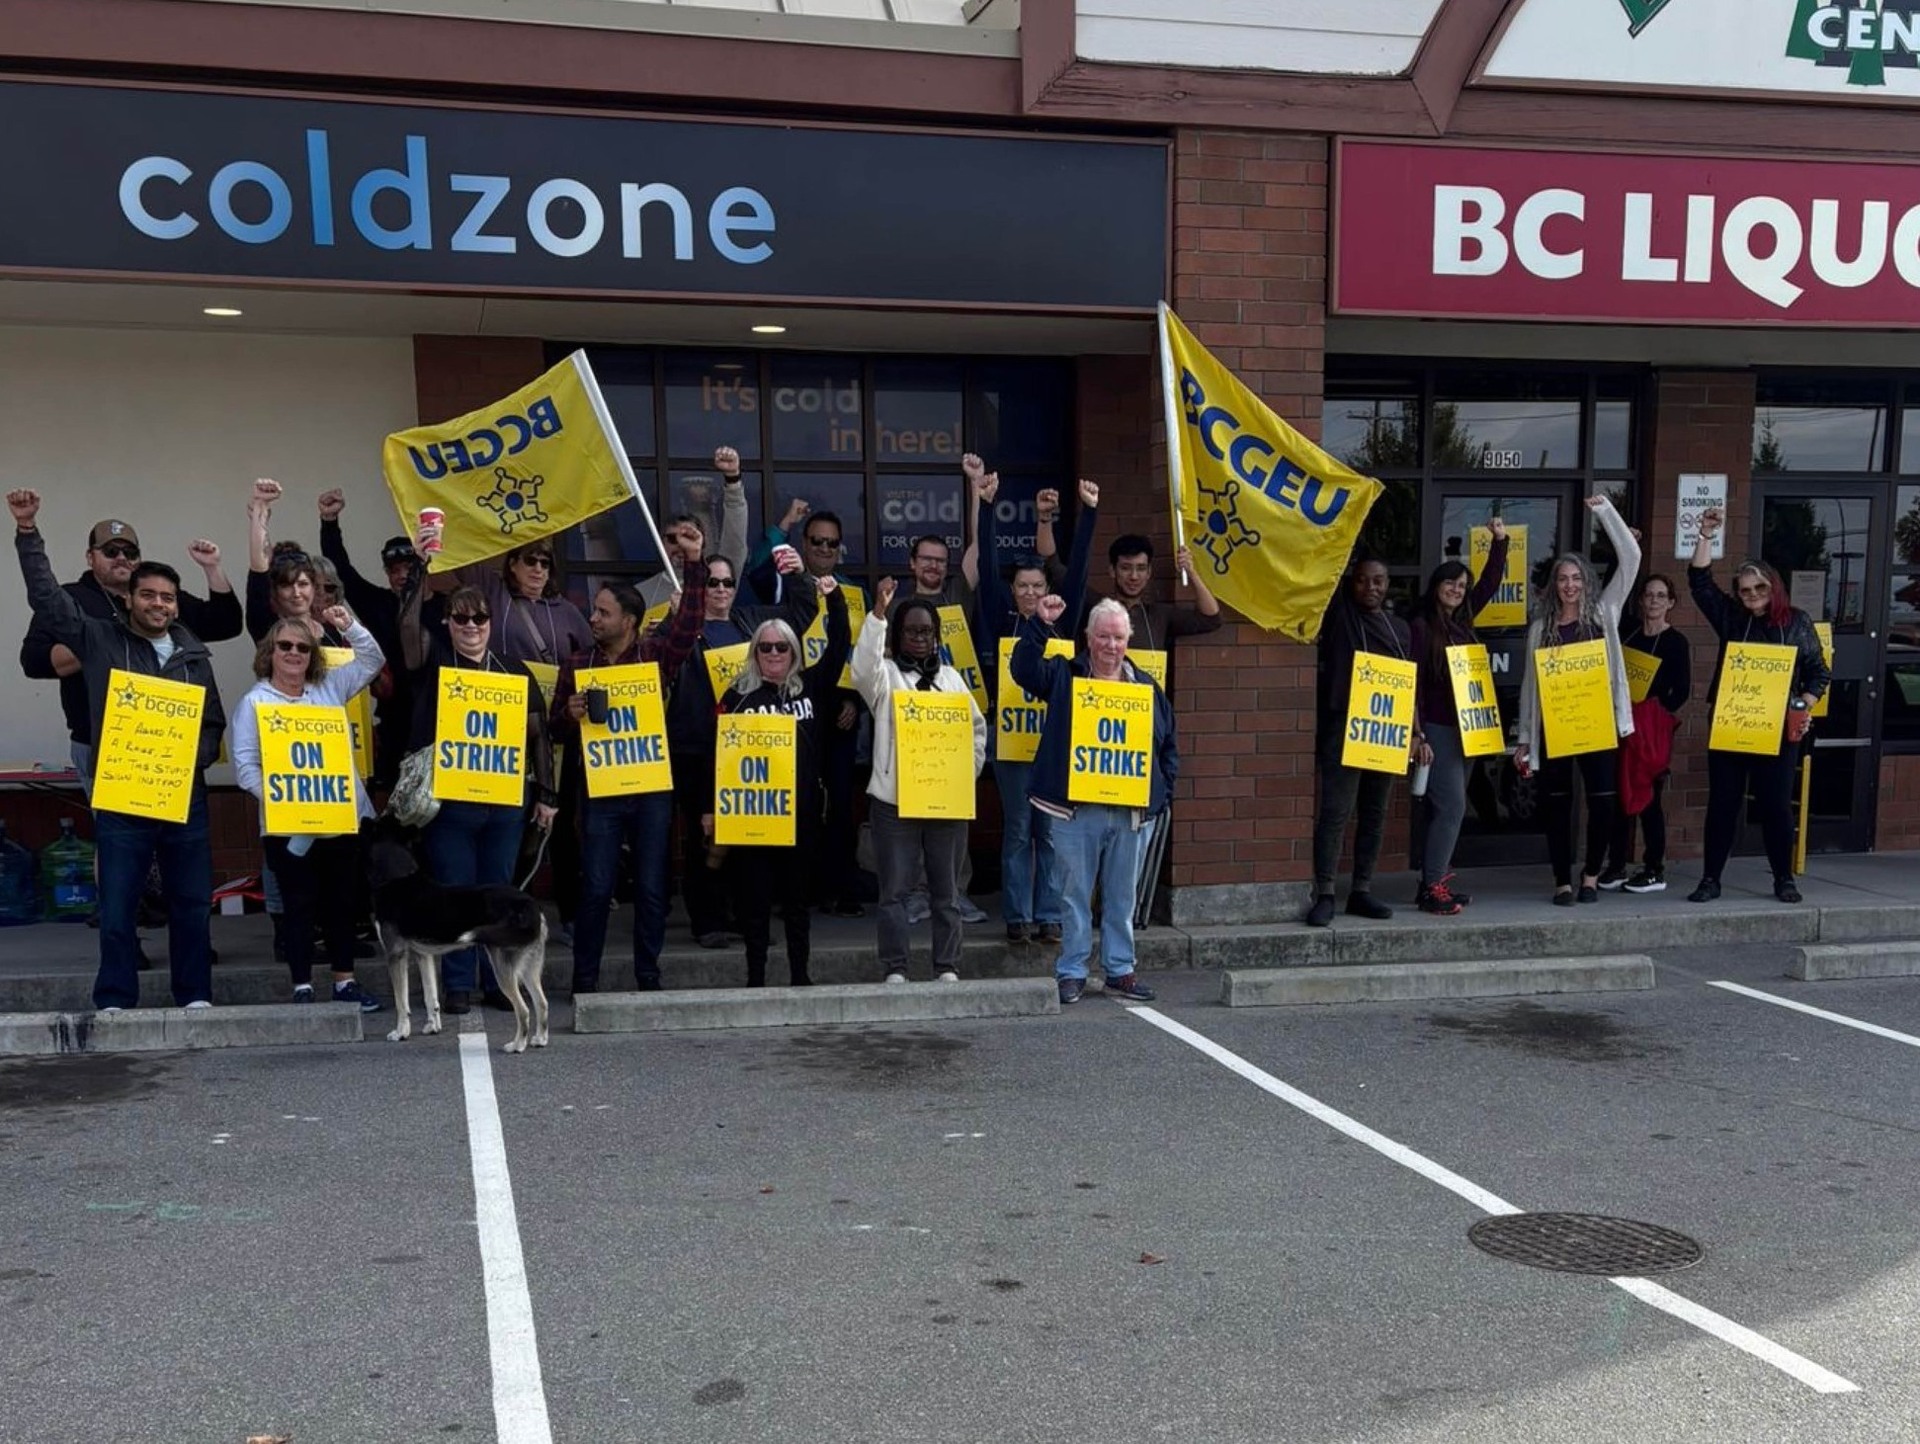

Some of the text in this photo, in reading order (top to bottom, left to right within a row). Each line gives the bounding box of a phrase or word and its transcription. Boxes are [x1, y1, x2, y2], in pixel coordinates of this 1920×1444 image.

[119, 129, 776, 264] coldzone
[1433, 184, 1585, 279] BC
[703, 376, 858, 413] It's cold
[829, 419, 961, 453] in here!
[1181, 366, 1350, 526] BCGEU
[1485, 451, 1520, 467] 9050
[1682, 498, 1722, 507] SMOKING
[1696, 486, 1710, 496] NO
[883, 535, 908, 548] FOR
[1565, 655, 1604, 672] bcgeu
[1626, 666, 1652, 683] cgeu
[1750, 659, 1790, 673] bcgeu
[611, 681, 657, 698] bcgeu
[1378, 669, 1413, 689] bcgeu
[1468, 680, 1483, 703] ON
[145, 697, 198, 719] bcgeu
[474, 687, 523, 705] bcgeu
[1105, 698, 1149, 713] bcgeu
[1371, 692, 1394, 718] ON
[294, 719, 345, 735] bcgeu
[465, 709, 497, 739] ON
[607, 705, 637, 733] ON
[927, 709, 969, 723] bcgeu
[1001, 707, 1047, 734] STRI
[1460, 706, 1500, 732] STRIKE
[746, 732, 792, 748] bcgeu
[1098, 717, 1126, 744] ON
[1350, 717, 1409, 748] STRIKE
[291, 741, 324, 769] ON
[439, 740, 521, 775] STRIKE
[587, 734, 665, 768] STRIKE
[1074, 746, 1147, 778] STRIKE
[740, 756, 769, 784] ON
[269, 773, 351, 803] STRIKE
[719, 788, 791, 816] STRIKE
